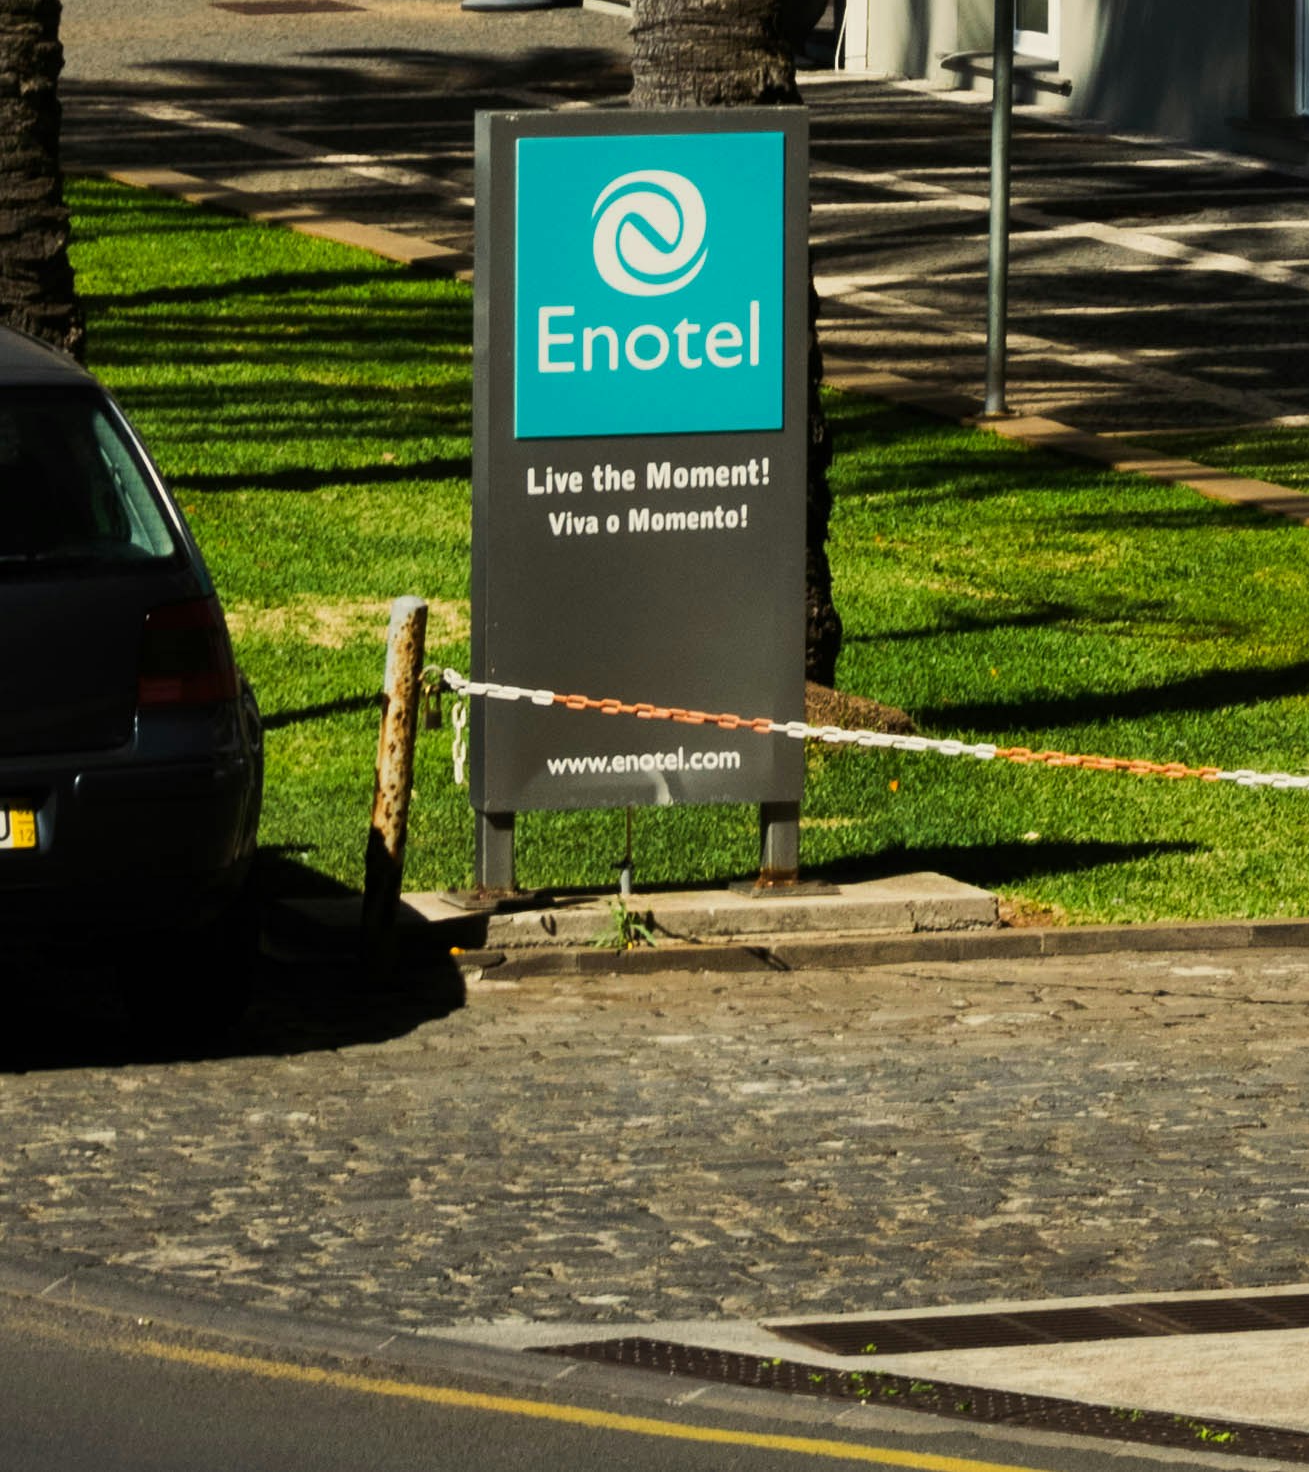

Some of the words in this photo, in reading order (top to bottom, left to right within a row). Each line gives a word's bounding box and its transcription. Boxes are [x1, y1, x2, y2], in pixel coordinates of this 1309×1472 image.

[537, 299, 761, 374] Enotel
[526, 466, 584, 496] Live
[591, 462, 637, 492] the
[646, 456, 771, 491] Moment!
[548, 510, 600, 537] Viva
[606, 513, 621, 534] o
[628, 503, 749, 533] Momento!
[546, 745, 742, 776] www.enotel.com
